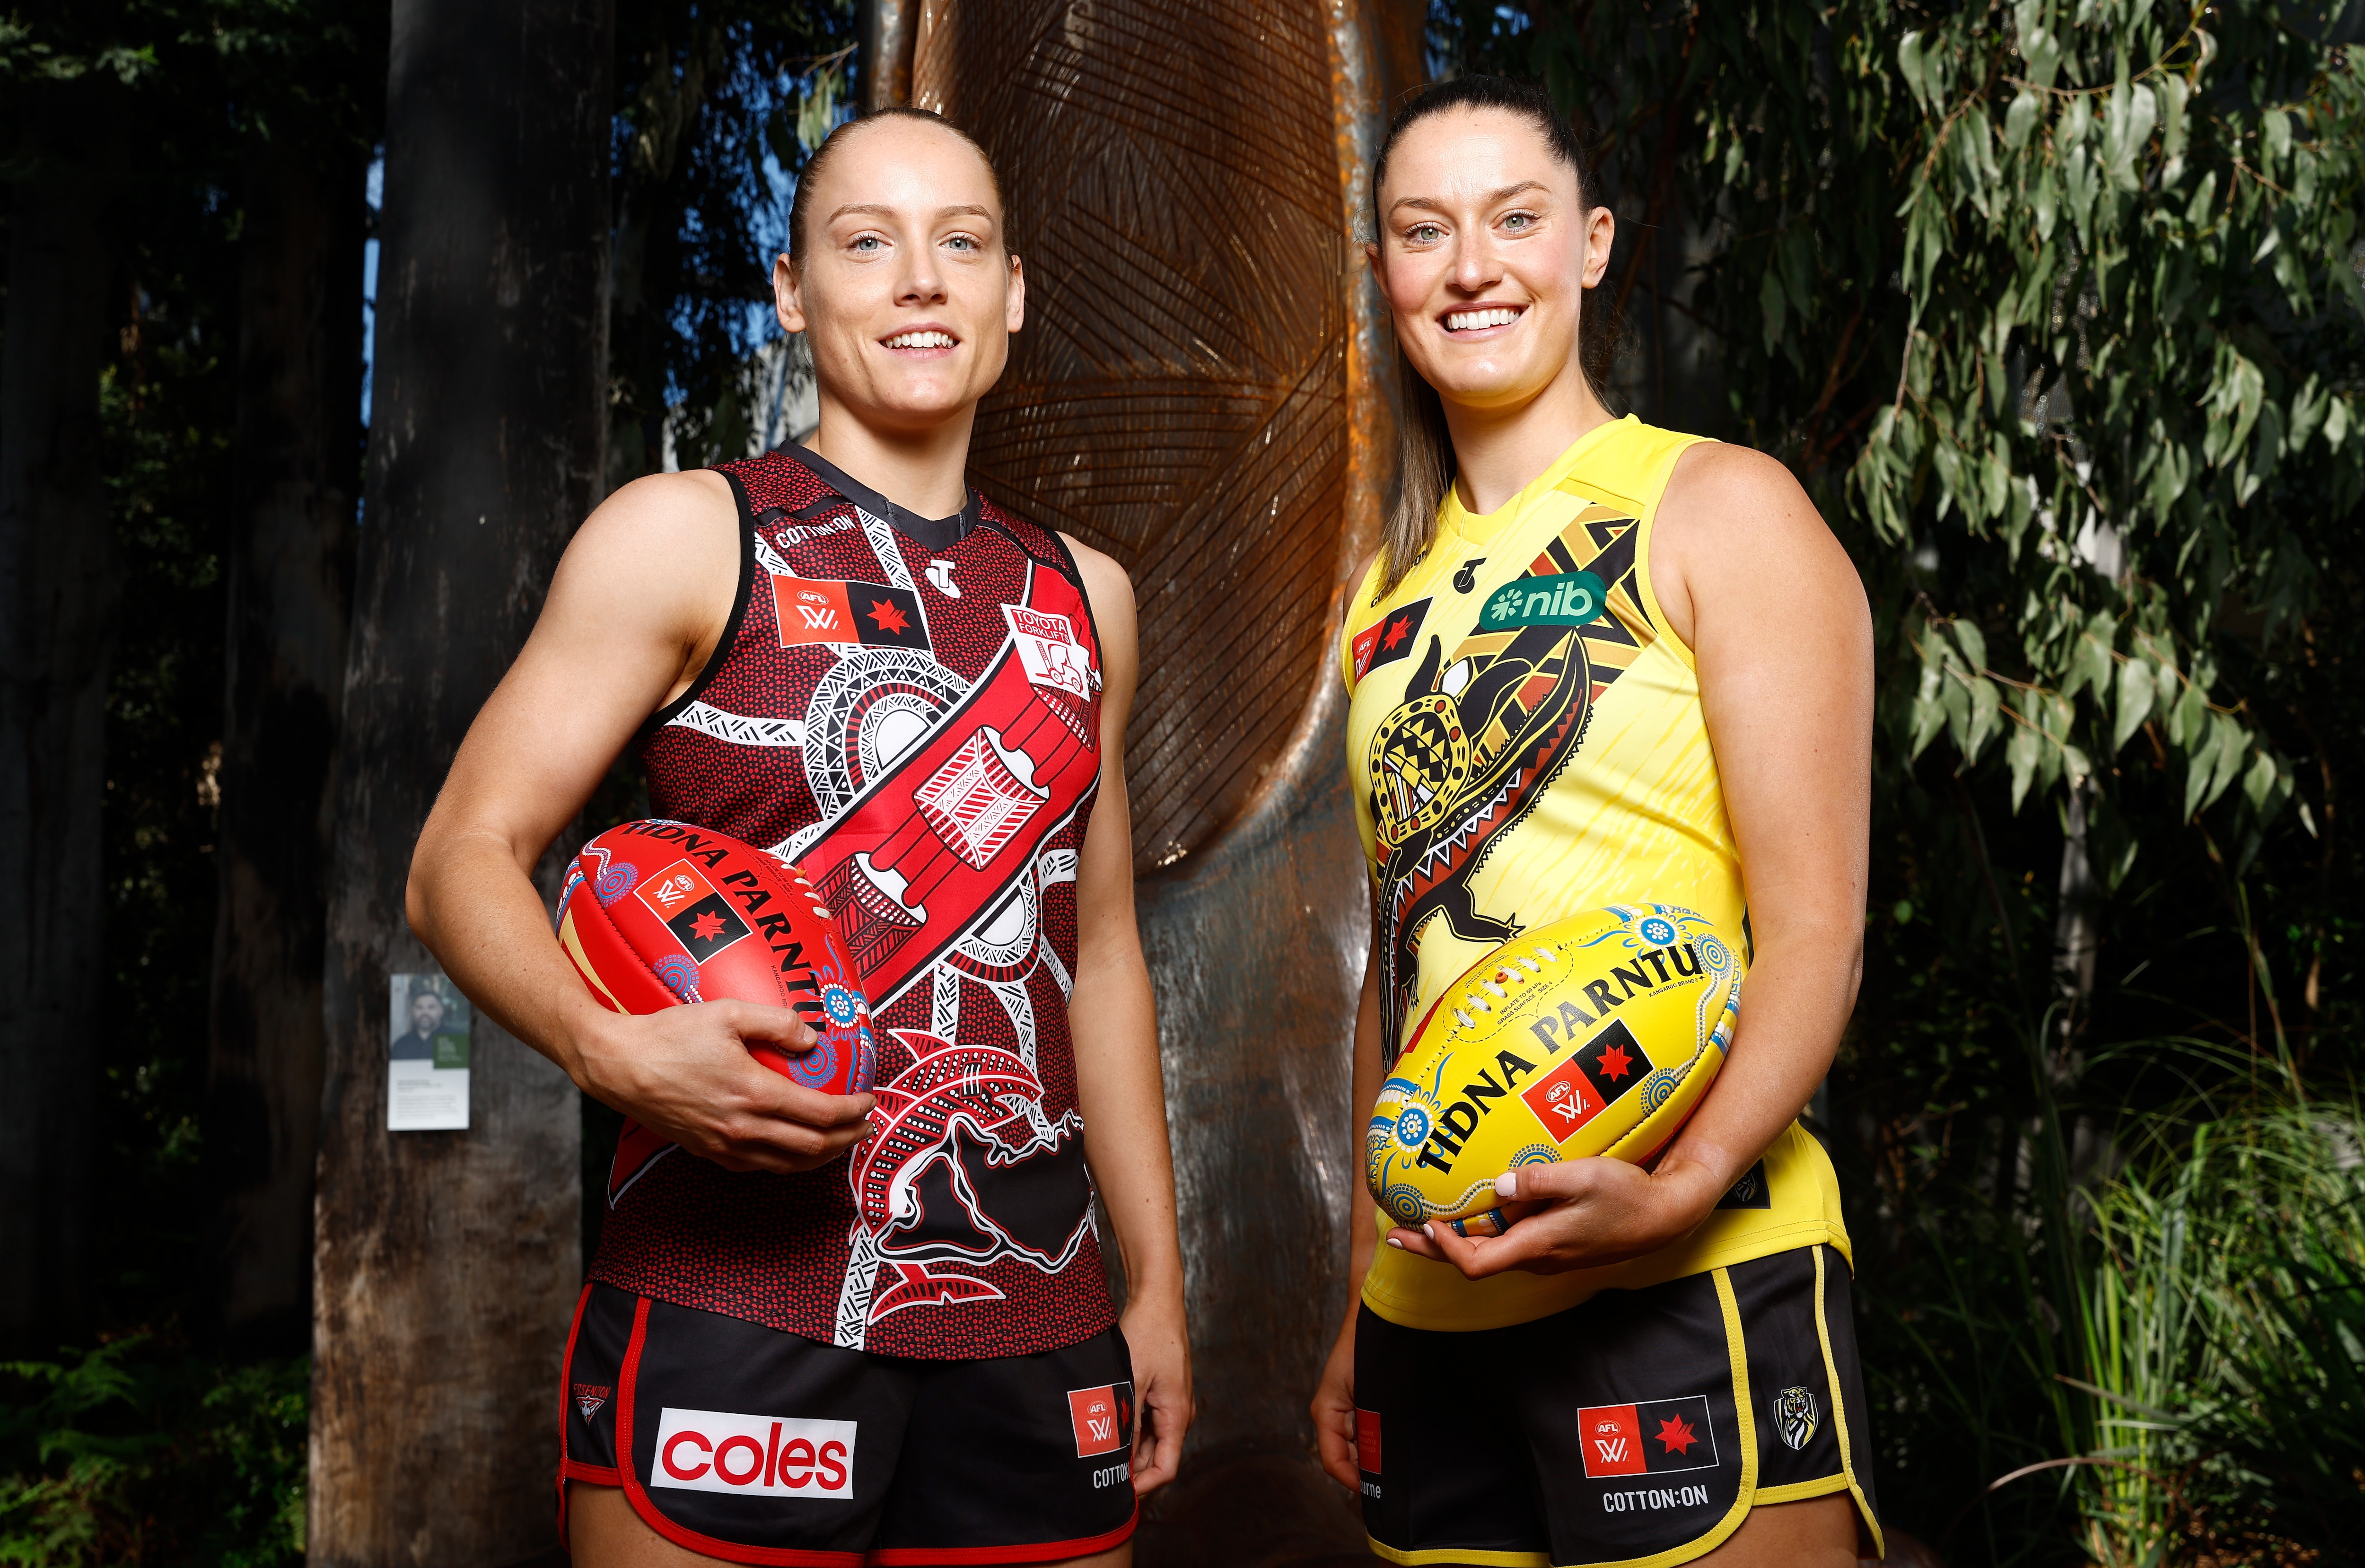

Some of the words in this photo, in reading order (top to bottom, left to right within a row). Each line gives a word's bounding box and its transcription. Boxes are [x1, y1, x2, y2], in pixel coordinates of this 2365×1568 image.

[776, 515, 856, 548] COTTON:ON
[801, 593, 826, 603] AFL
[1521, 581, 1592, 617] nib
[1013, 610, 1067, 634] TOYOTA
[1018, 623, 1070, 643] FORKLIFTS
[1358, 639, 1371, 653] AFL
[676, 877, 691, 890] AFL
[620, 822, 729, 869] TIDNA
[720, 869, 826, 1032] PARNTU
[771, 965, 786, 997] KANGAROO
[1648, 983, 1677, 998] KANGAROO
[1497, 1011, 1515, 1025] GRASS
[1515, 994, 1536, 1012] SURFACE
[1537, 984, 1549, 993] SIZE
[1500, 996, 1520, 1015] INFLATE
[1533, 981, 1542, 990] kPa
[1416, 1049, 1538, 1176] TIDNA
[1529, 944, 1704, 1055] PARNTU
[1550, 1085, 1569, 1101] AFL
[1089, 1403, 1106, 1413] AFL
[1598, 1424, 1619, 1433] AFL
[662, 1422, 847, 1490] coles
[1603, 1485, 1708, 1512] COTTON:ON
